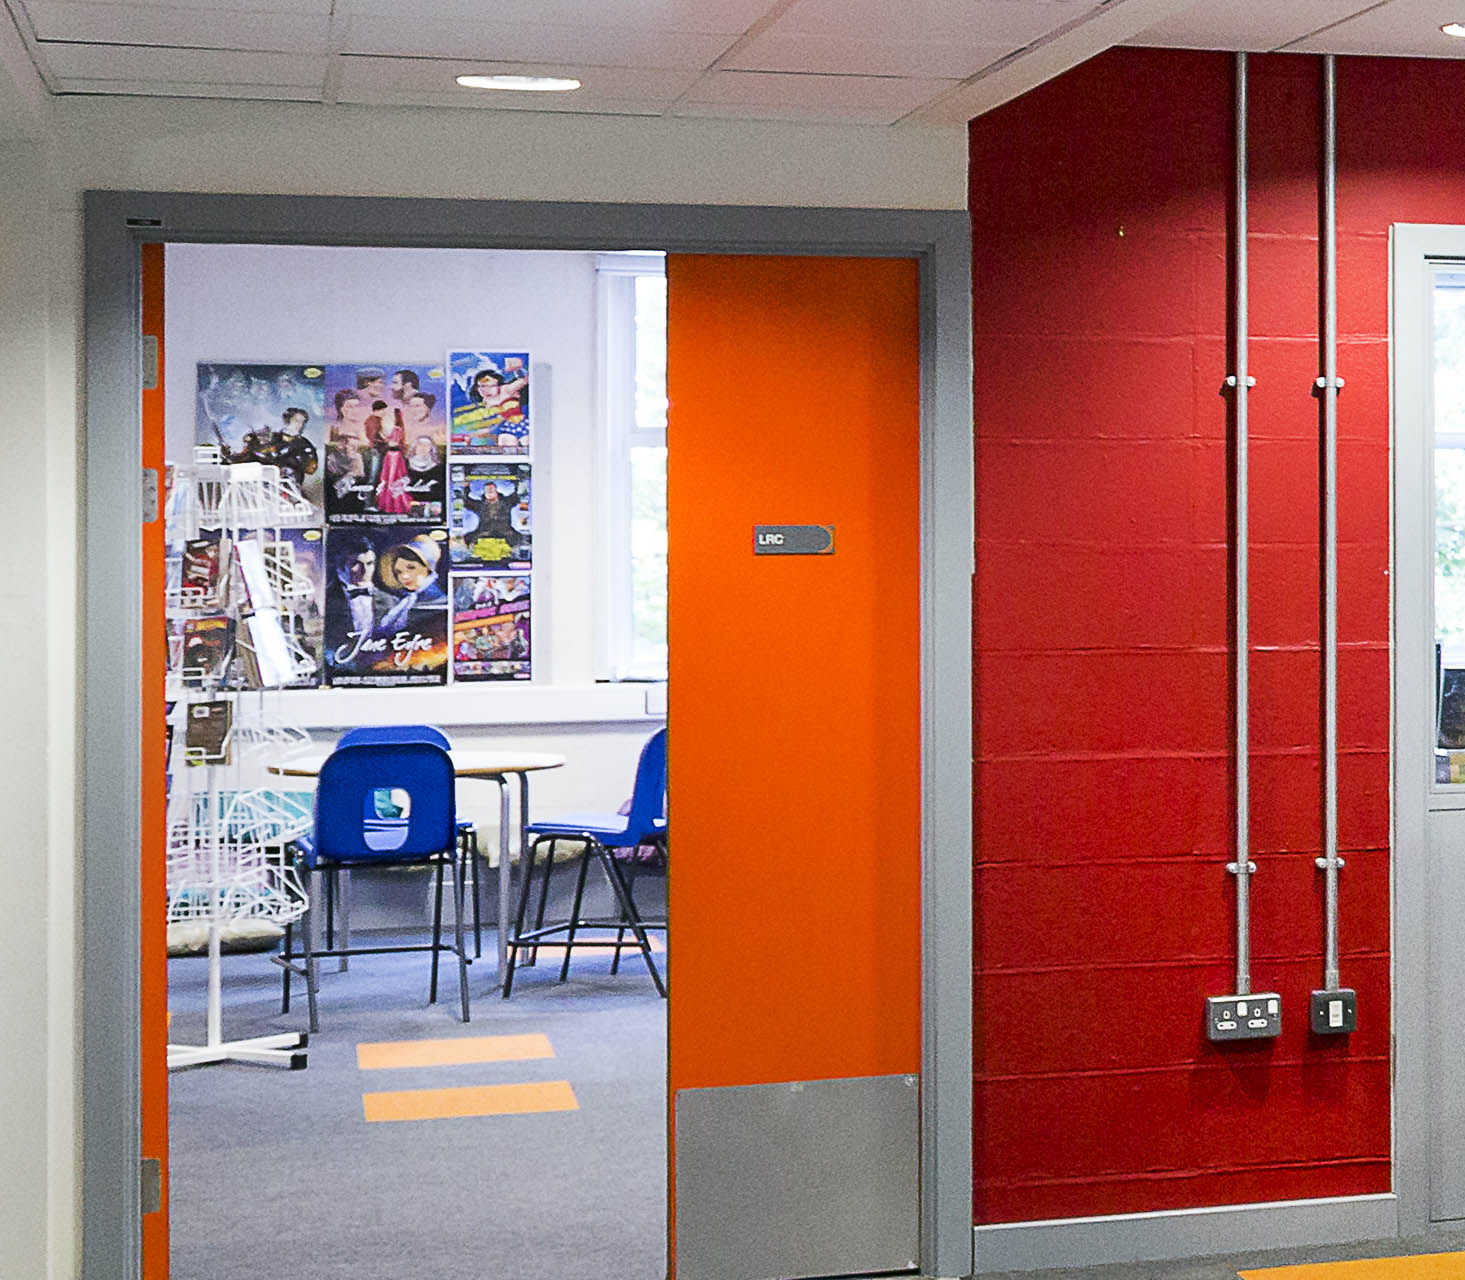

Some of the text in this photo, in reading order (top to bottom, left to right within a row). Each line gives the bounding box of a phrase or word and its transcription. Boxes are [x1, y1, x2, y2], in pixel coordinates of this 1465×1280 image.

[758, 533, 784, 545] LRC
[335, 629, 432, 667] Jane Eyre
